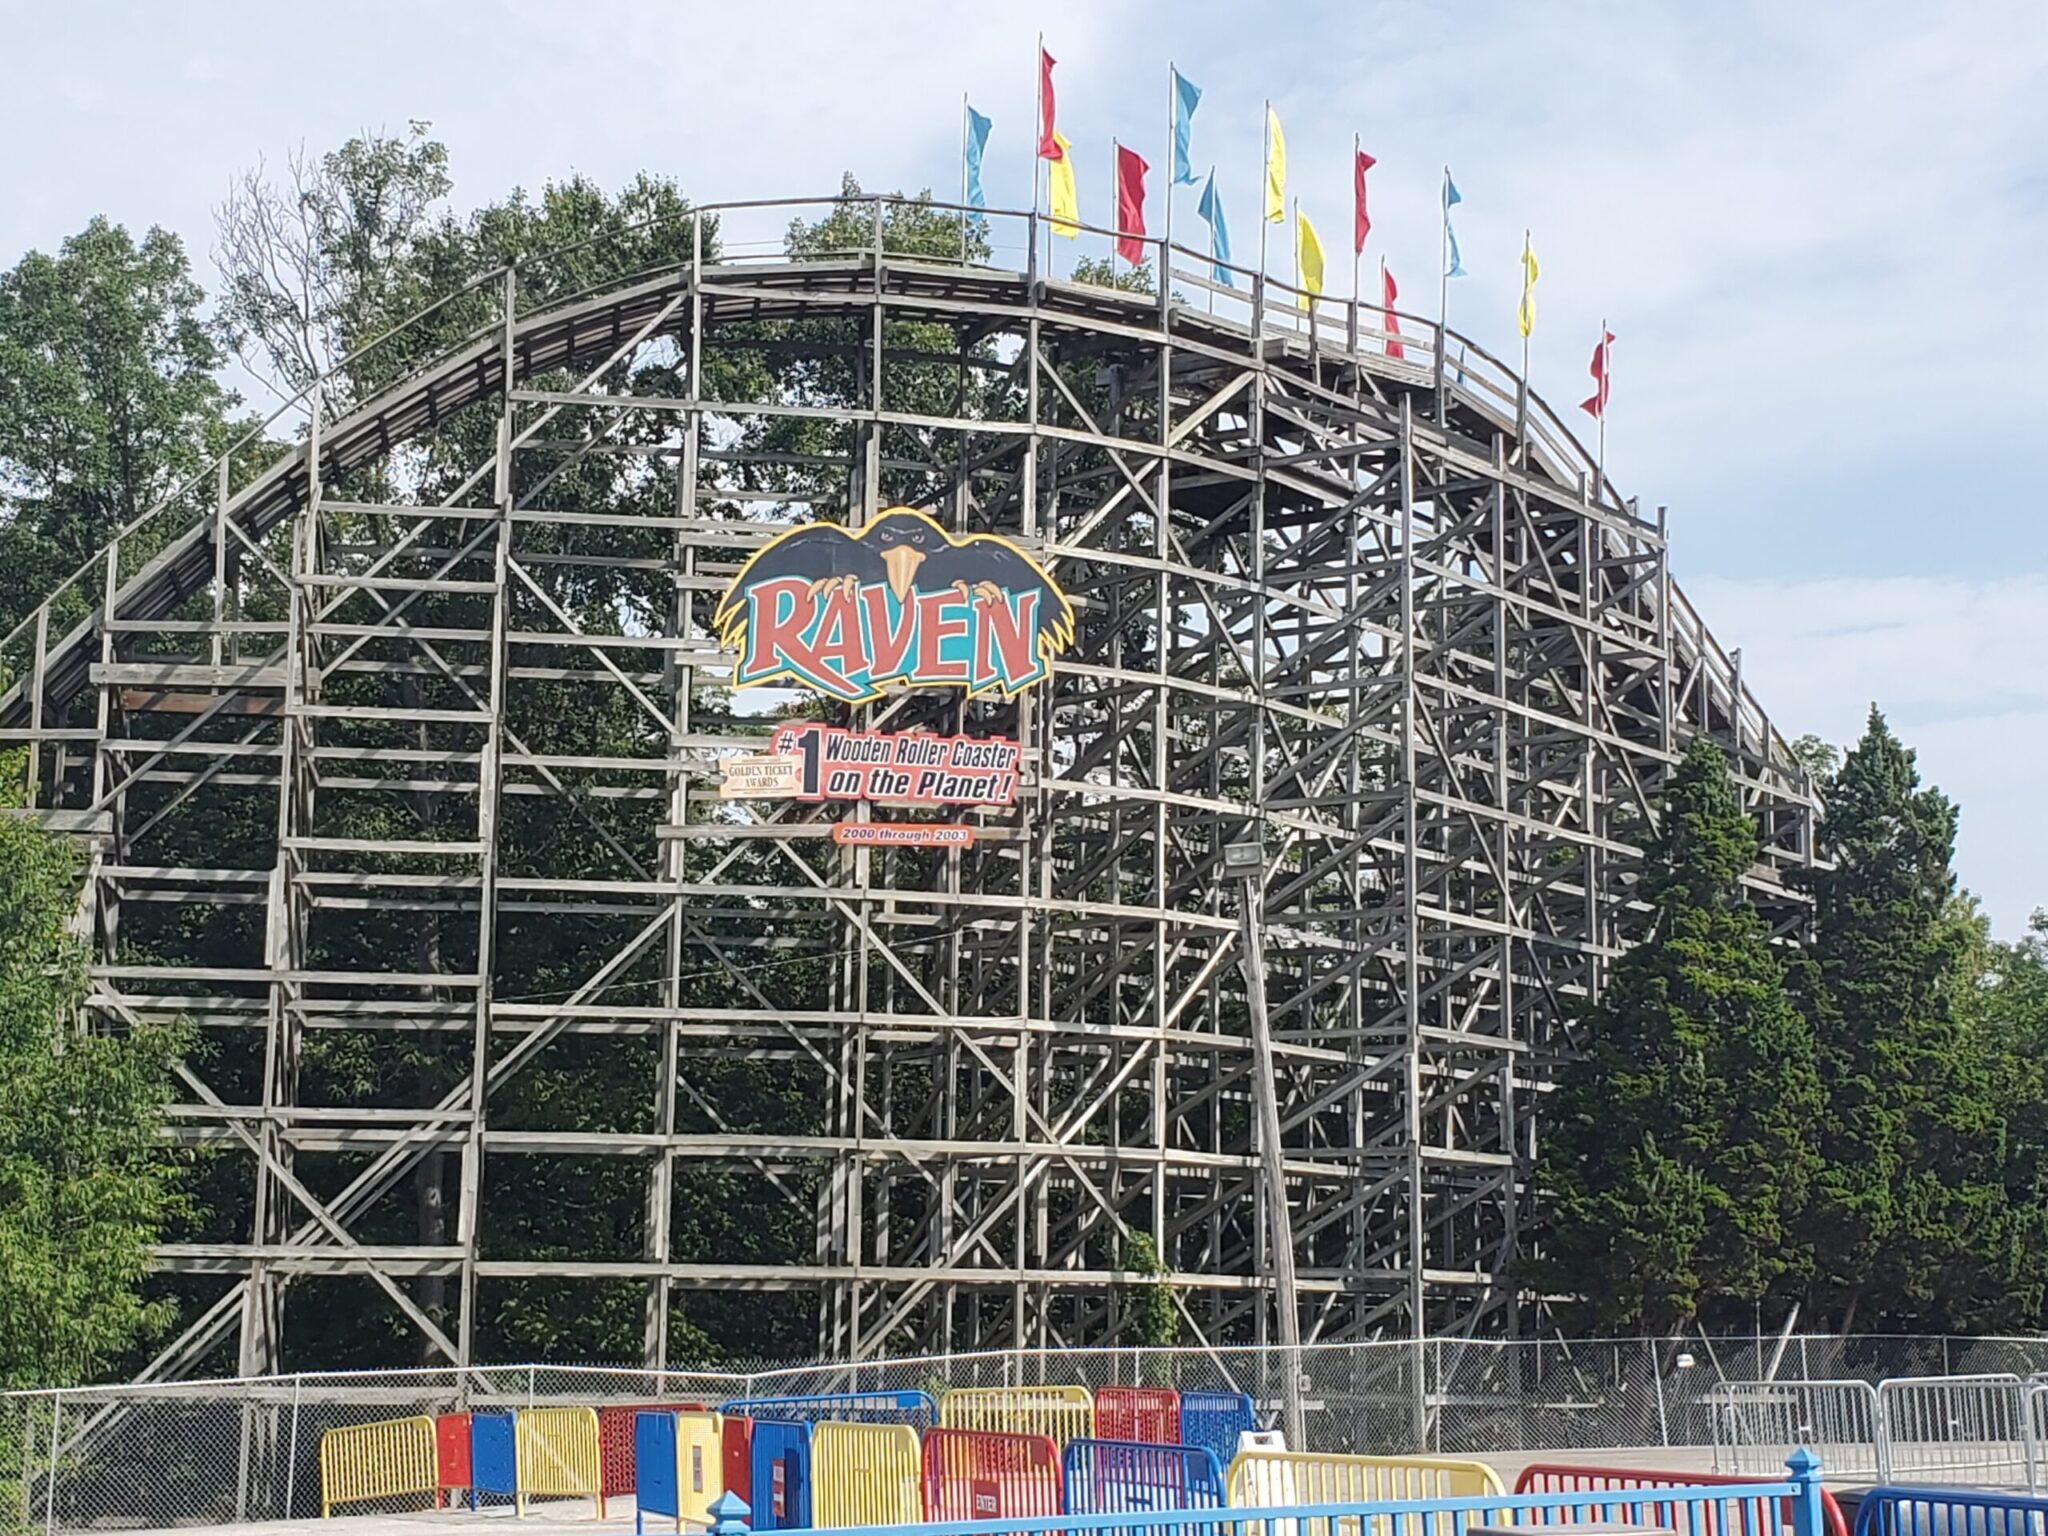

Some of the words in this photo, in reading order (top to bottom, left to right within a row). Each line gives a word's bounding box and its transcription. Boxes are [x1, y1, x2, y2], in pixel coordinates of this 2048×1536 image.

[743, 578, 1040, 695] RAVEN
[826, 734, 891, 762] Wooden
[895, 738, 947, 765] Roller
[951, 740, 1016, 769] Coaster
[728, 766, 762, 776] GOLDEN
[764, 765, 793, 776] TICKET
[744, 777, 779, 787] AWARDS
[828, 771, 861, 793] on
[869, 769, 910, 795] the
[843, 828, 875, 839] 2000
[879, 830, 930, 842] through
[935, 831, 967, 841] 2003
